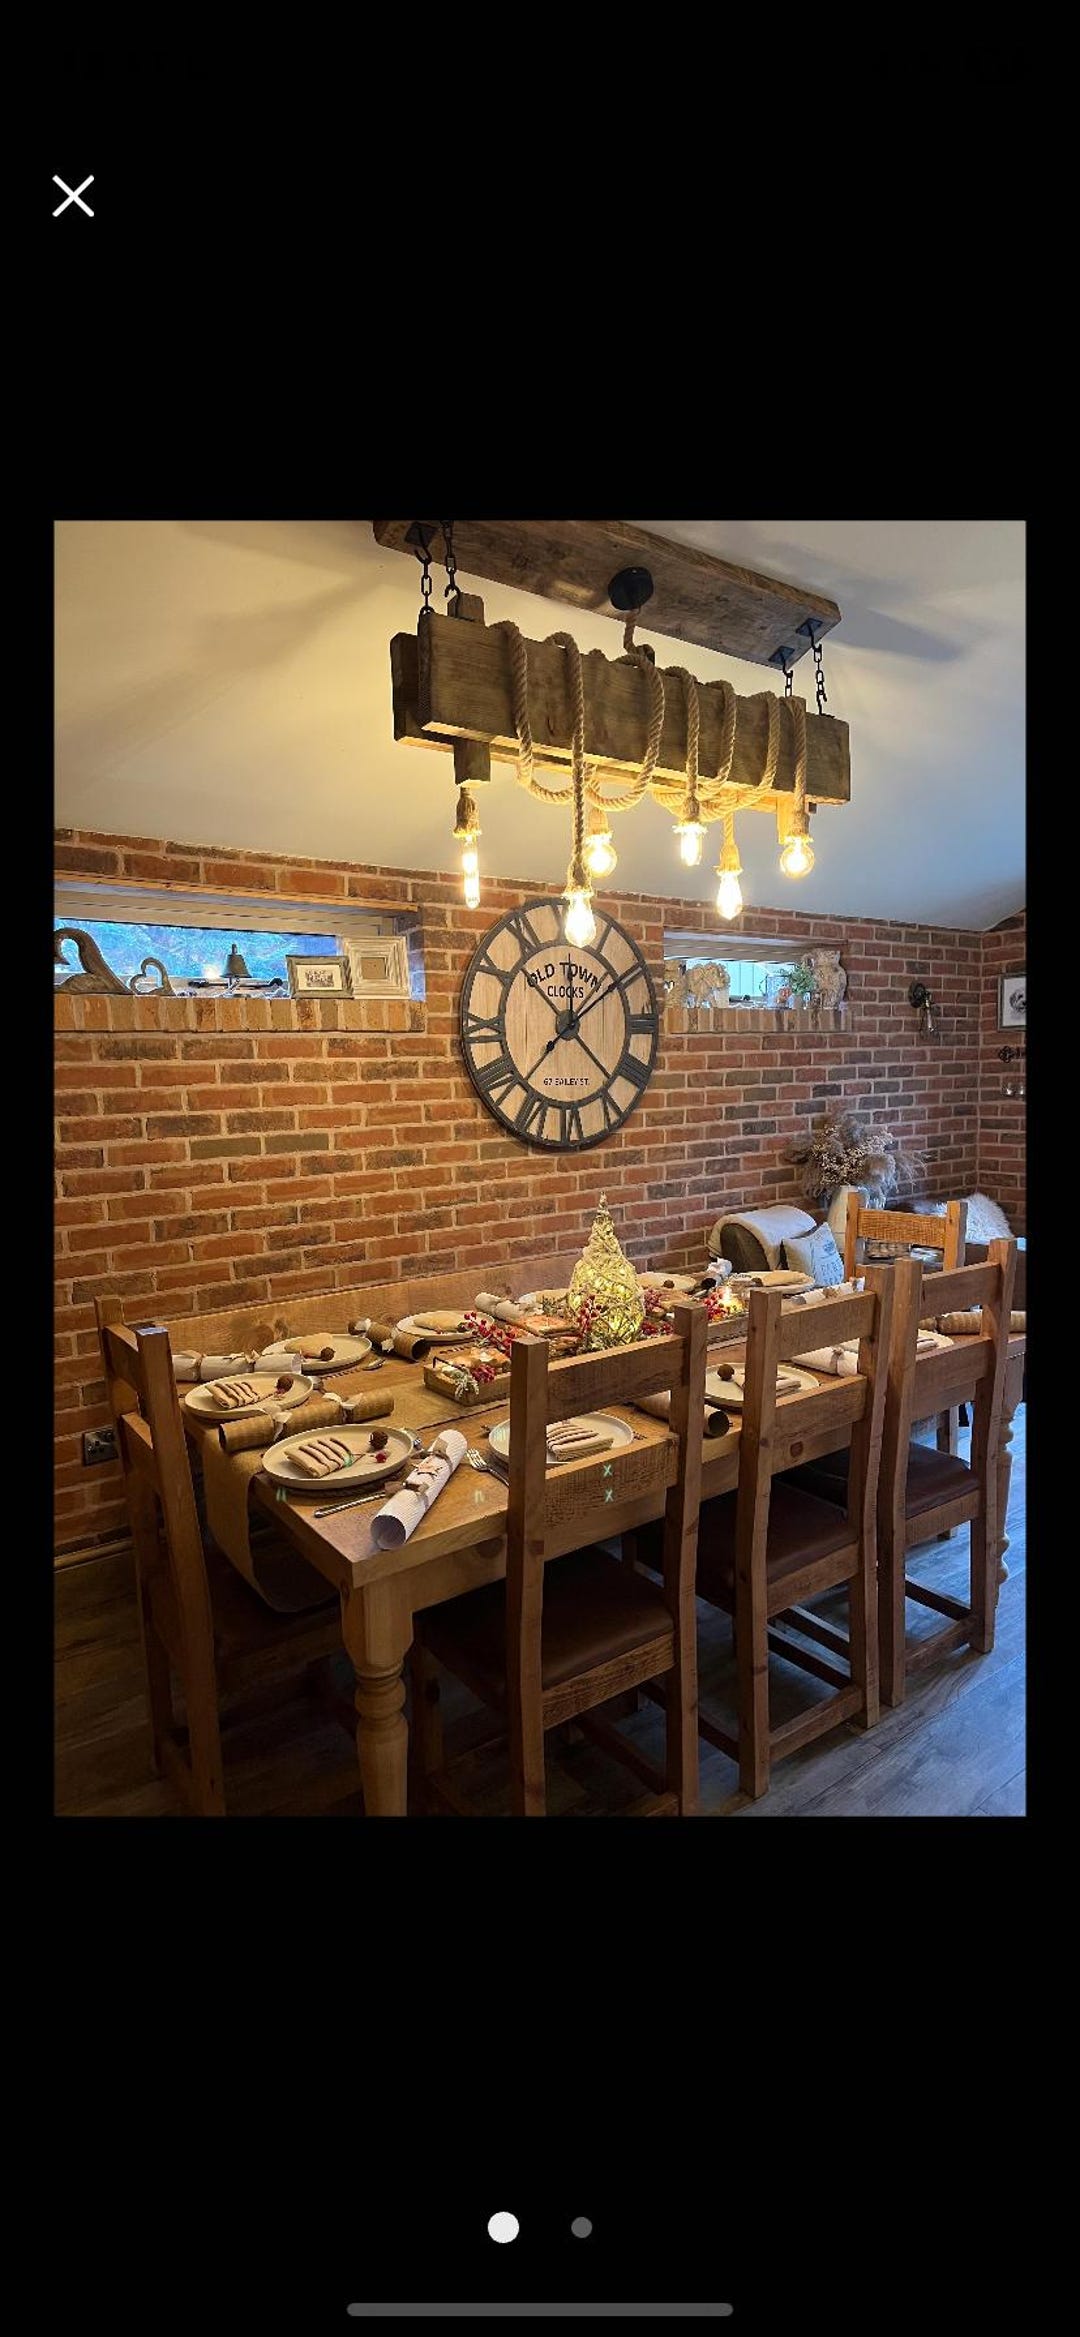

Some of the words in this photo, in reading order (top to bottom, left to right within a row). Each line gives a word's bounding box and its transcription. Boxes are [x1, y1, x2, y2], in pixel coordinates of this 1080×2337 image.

[526, 963, 555, 988] OLD
[559, 962, 602, 993] TOWN
[547, 985, 584, 999] CLOCKS
